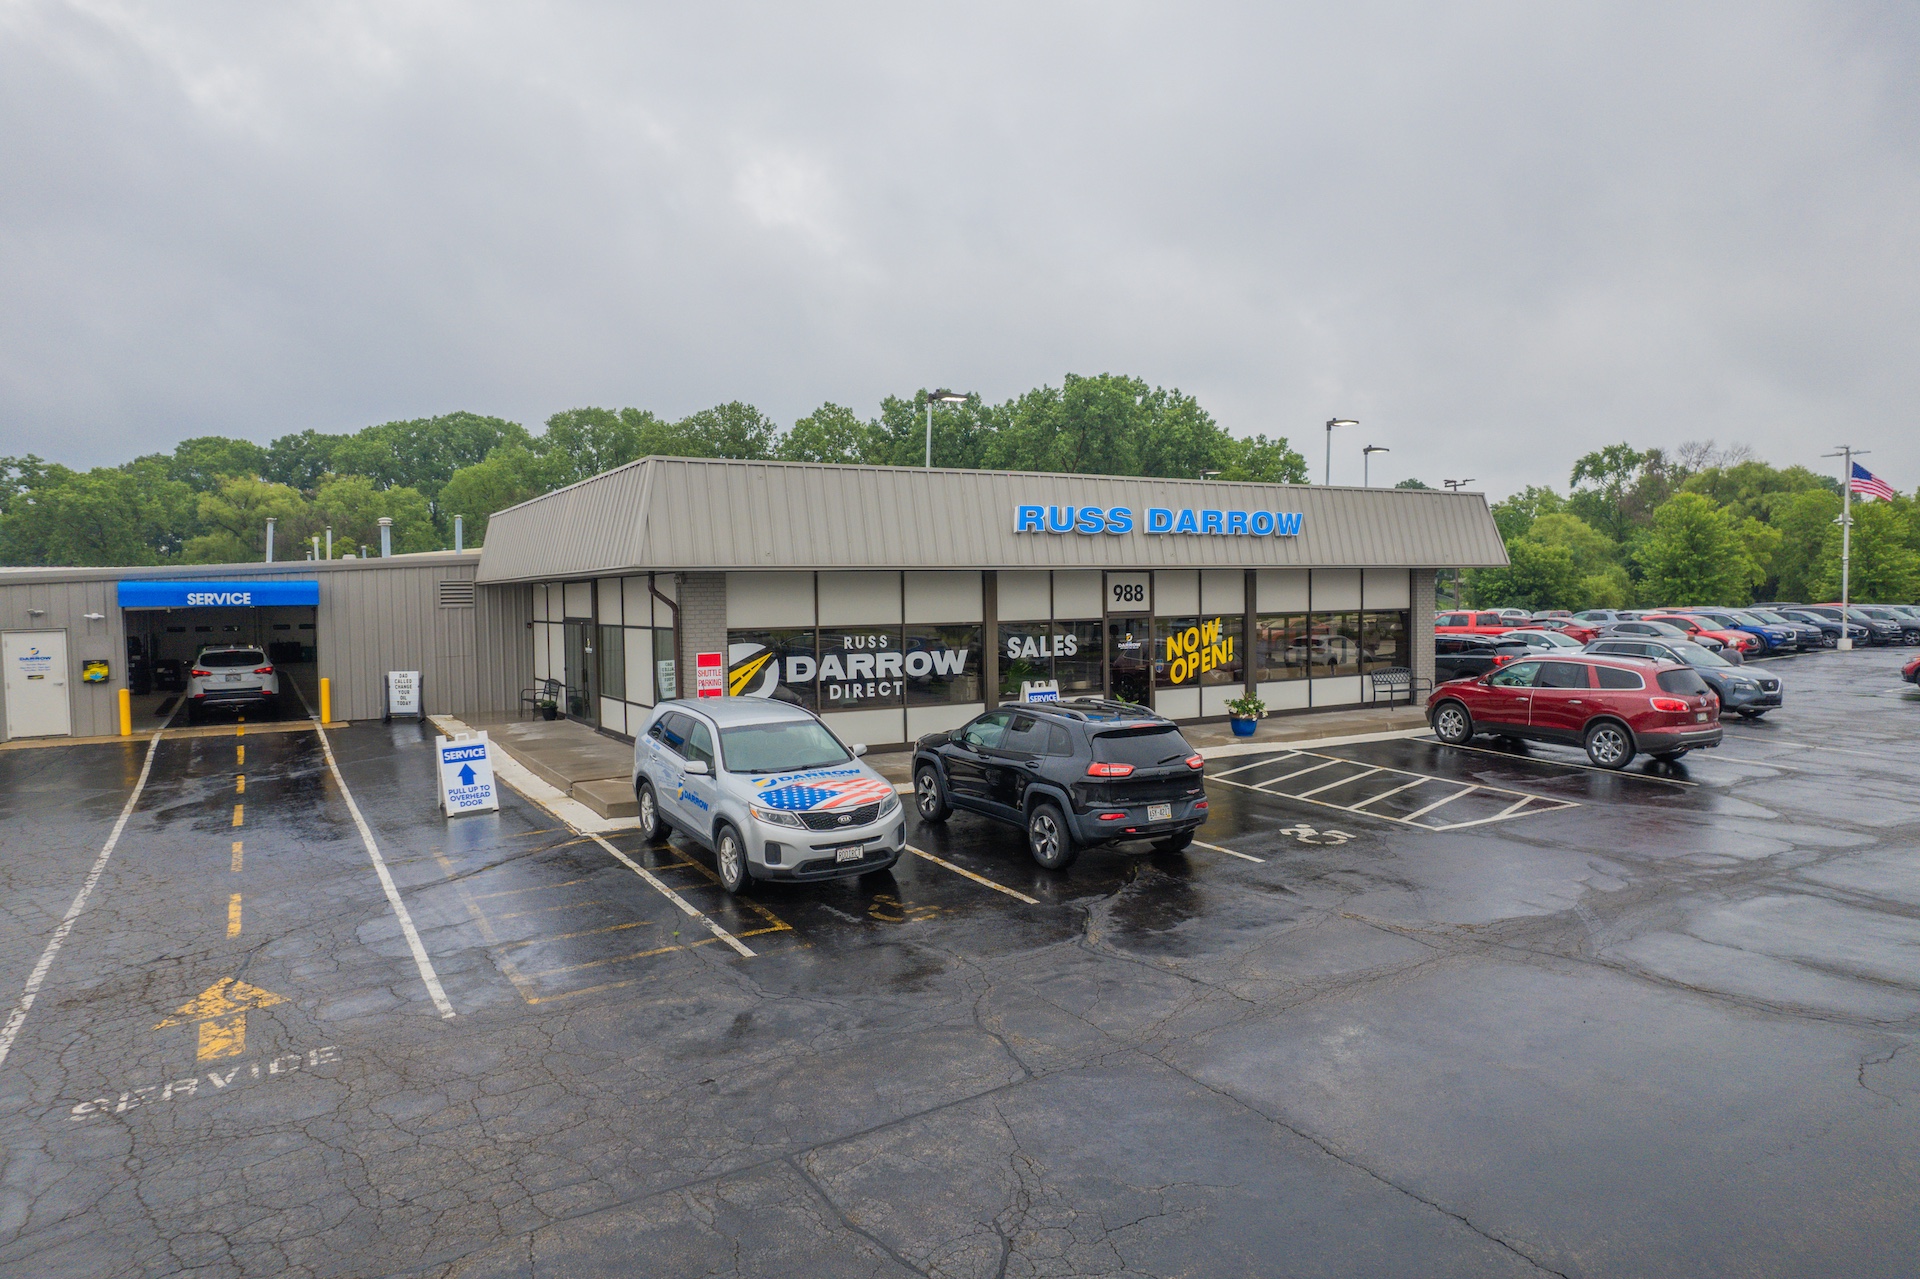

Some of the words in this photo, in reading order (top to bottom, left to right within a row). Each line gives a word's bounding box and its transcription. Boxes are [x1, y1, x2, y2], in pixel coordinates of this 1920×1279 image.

[1014, 505, 1133, 535] RUSS
[1144, 508, 1303, 537] DARROW
[187, 592, 252, 605] SERVICE
[1113, 584, 1144, 602] 988
[843, 635, 889, 650] RUSS
[1007, 634, 1078, 660] SALES
[1166, 617, 1221, 662] NOW
[785, 649, 969, 683] DARROW
[1169, 636, 1234, 685] OPEN!
[697, 668, 722, 678] SHUTTLE
[698, 679, 722, 687] PARKING
[829, 680, 903, 700] DIRECT
[1029, 694, 1057, 703] SERVICE
[443, 747, 485, 761] SERVICE
[778, 769, 860, 782] DARROW
[448, 787, 466, 795] PULL
[450, 791, 490, 802] OVERHEAD
[460, 799, 483, 808] DOOR
[684, 789, 709, 812] DARROW
[64, 1044, 342, 1122] SERVICE
